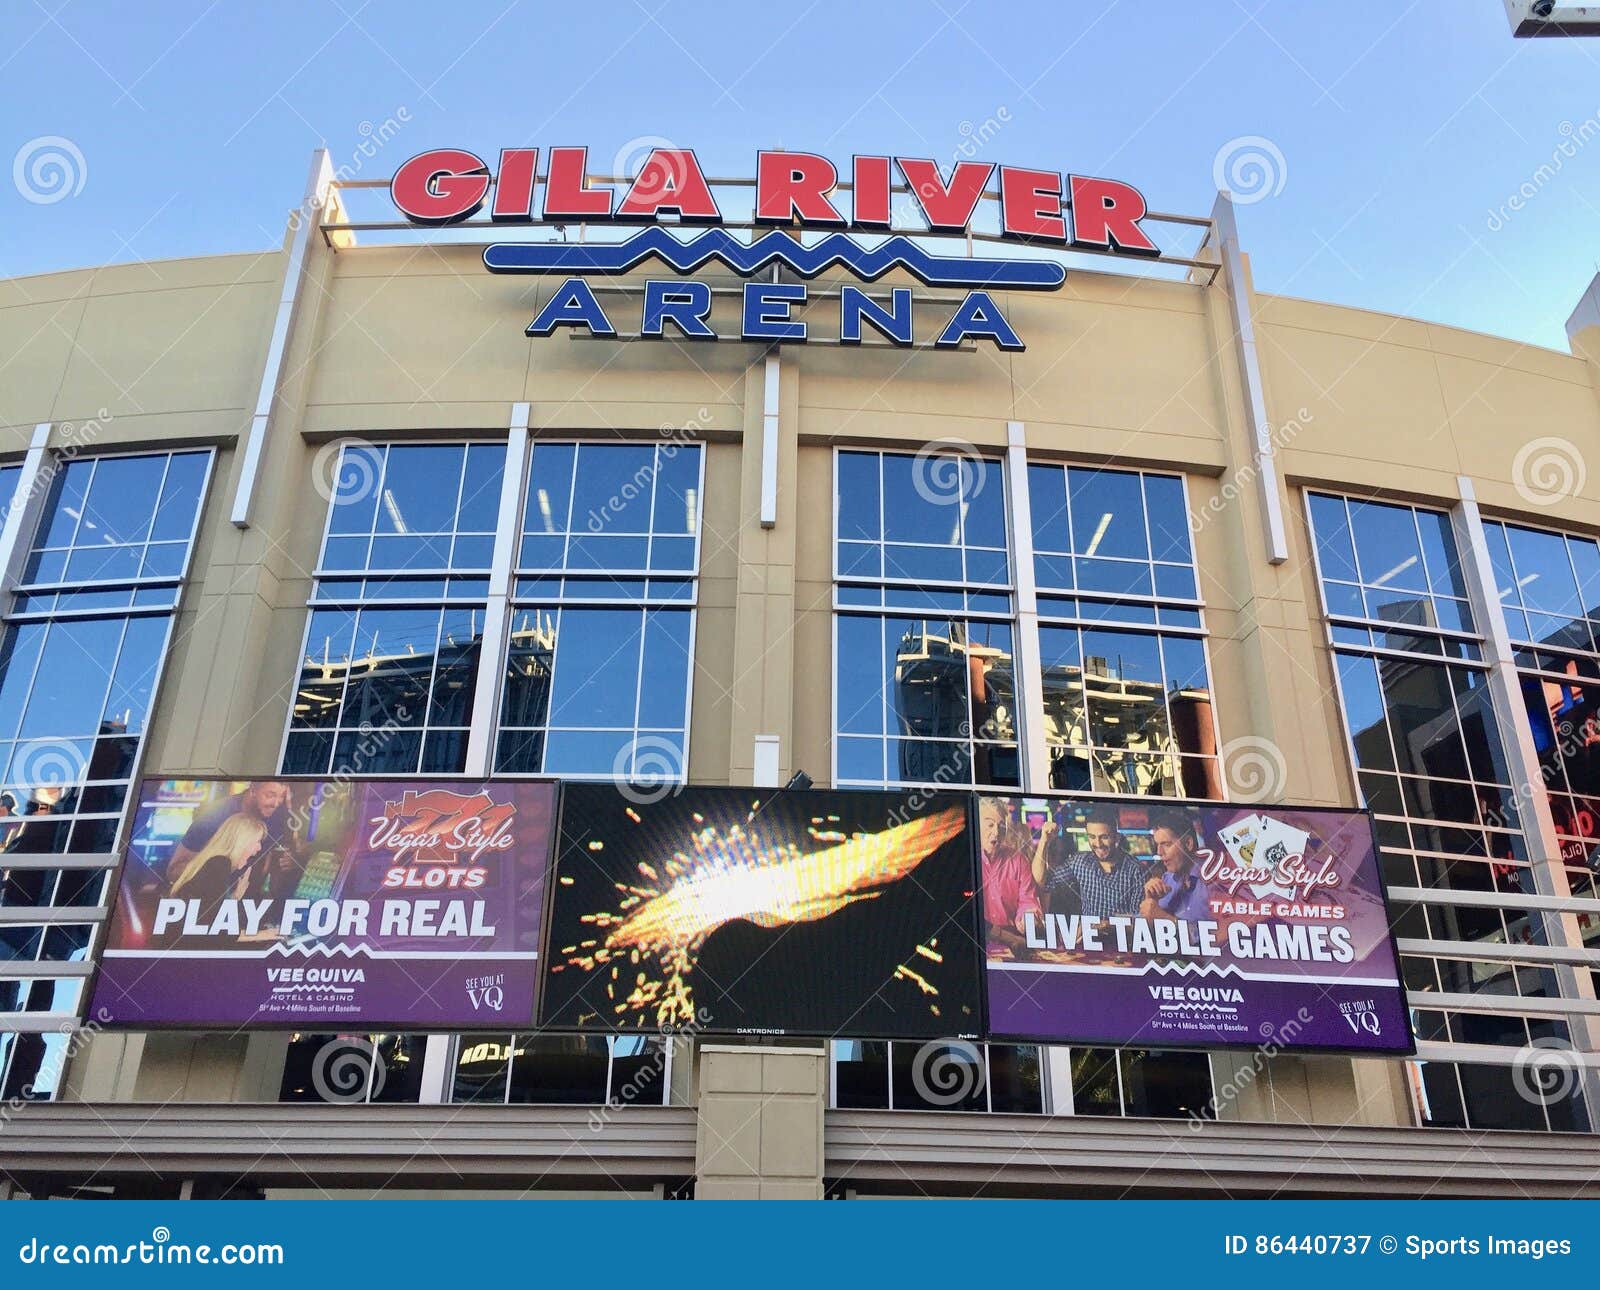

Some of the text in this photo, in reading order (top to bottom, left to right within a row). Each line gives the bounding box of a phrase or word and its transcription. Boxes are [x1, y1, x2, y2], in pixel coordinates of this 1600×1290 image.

[390, 146, 1161, 257] GILA RIVER
[524, 277, 1026, 352] ARENA
[369, 817, 514, 862] Vegas Style
[383, 867, 487, 888] SLOTS
[1196, 849, 1341, 899] Vegas Style
[152, 898, 496, 937] PLAY FOR REAL
[1209, 900, 1345, 919] TABLE GAMES
[1023, 912, 1355, 964] LIVE TABLE GAMES
[266, 968, 366, 983] VEE QUIVA
[465, 973, 504, 990] SEE YOU AT
[270, 994, 354, 1002] HOTEL & CASINO
[466, 985, 504, 1011] VQ
[1148, 985, 1245, 1003] VEE QUIVA
[308, 1003, 327, 1012] South
[1160, 1011, 1191, 1019] HOTEL
[1202, 1013, 1239, 1021] CASINO
[1339, 999, 1376, 1014] SEE YOU AT
[736, 1027, 785, 1035] DAKTRONICS
[1199, 1023, 1216, 1031] South
[1342, 1011, 1381, 1036] VQ
